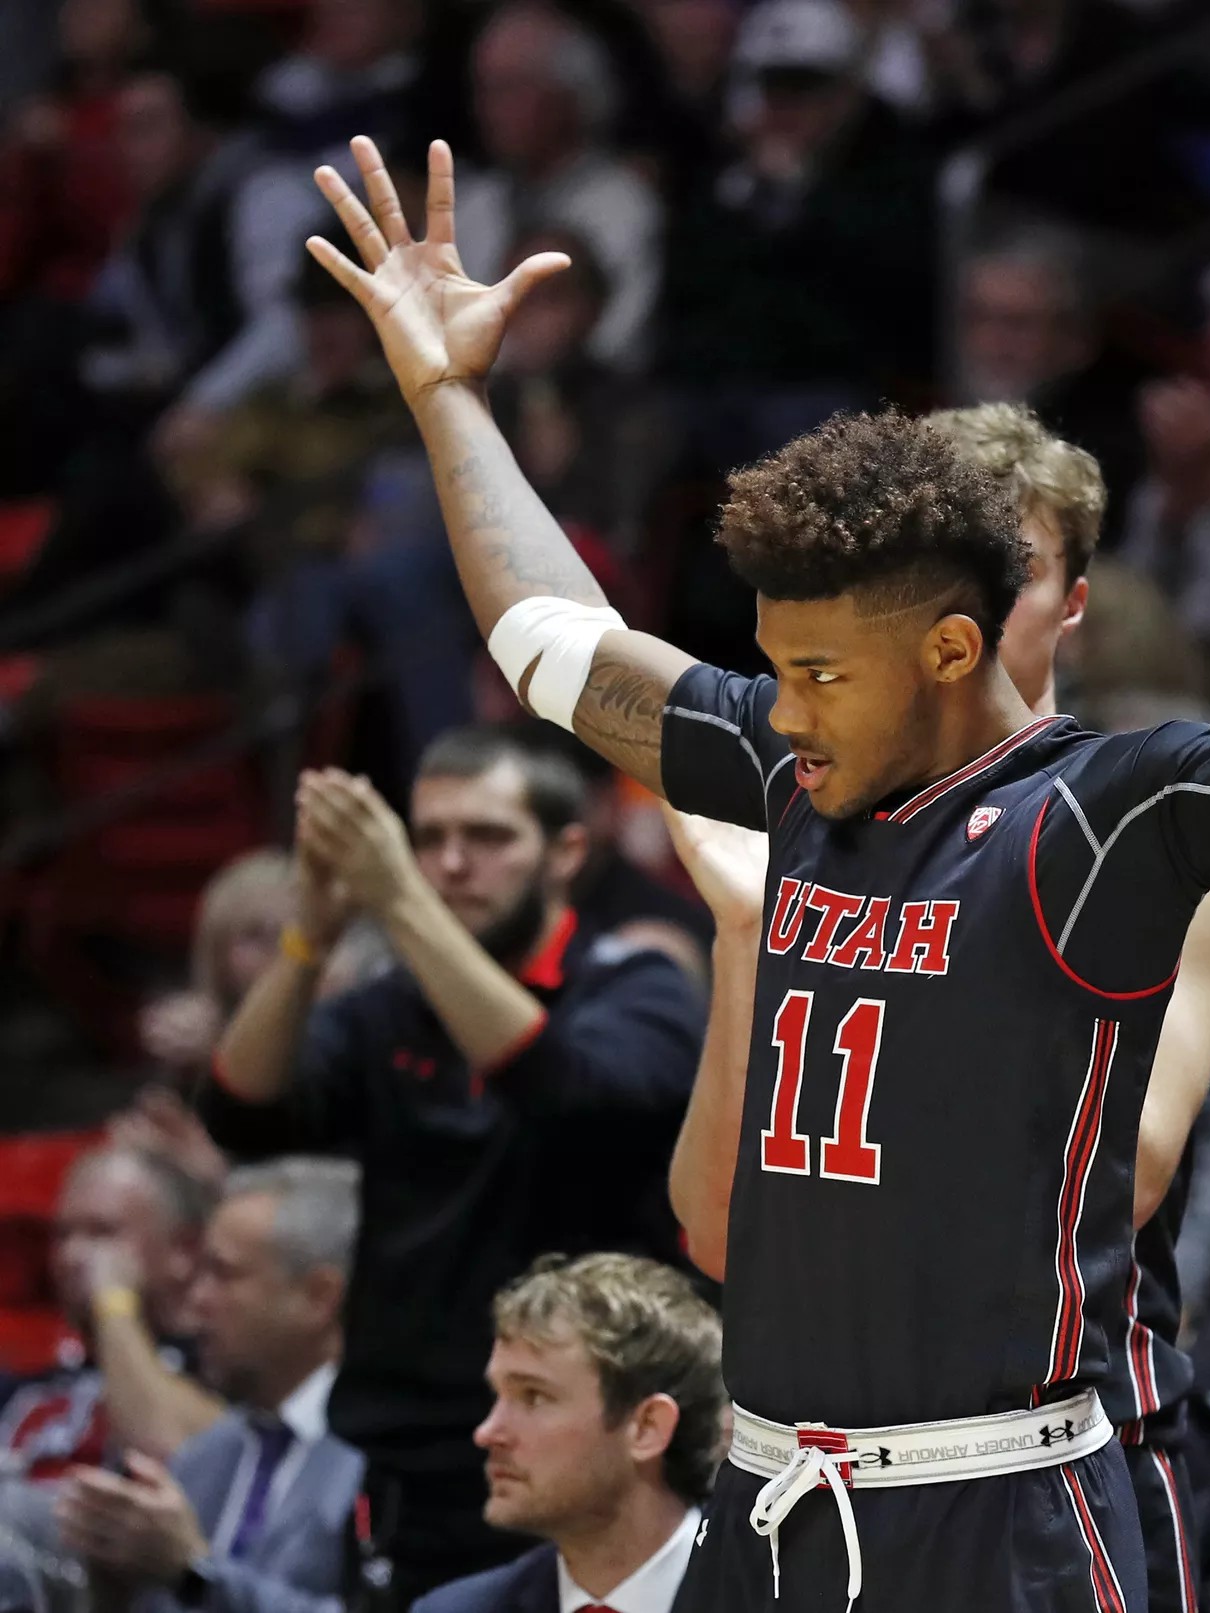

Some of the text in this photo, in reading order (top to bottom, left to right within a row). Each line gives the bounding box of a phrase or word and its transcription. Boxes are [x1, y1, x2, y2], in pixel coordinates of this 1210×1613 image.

[969, 820, 988, 834] 12
[767, 876, 960, 975] UTAH
[761, 989, 886, 1186] 11
[899, 1434, 1034, 1462] UNDER ARMOUR
